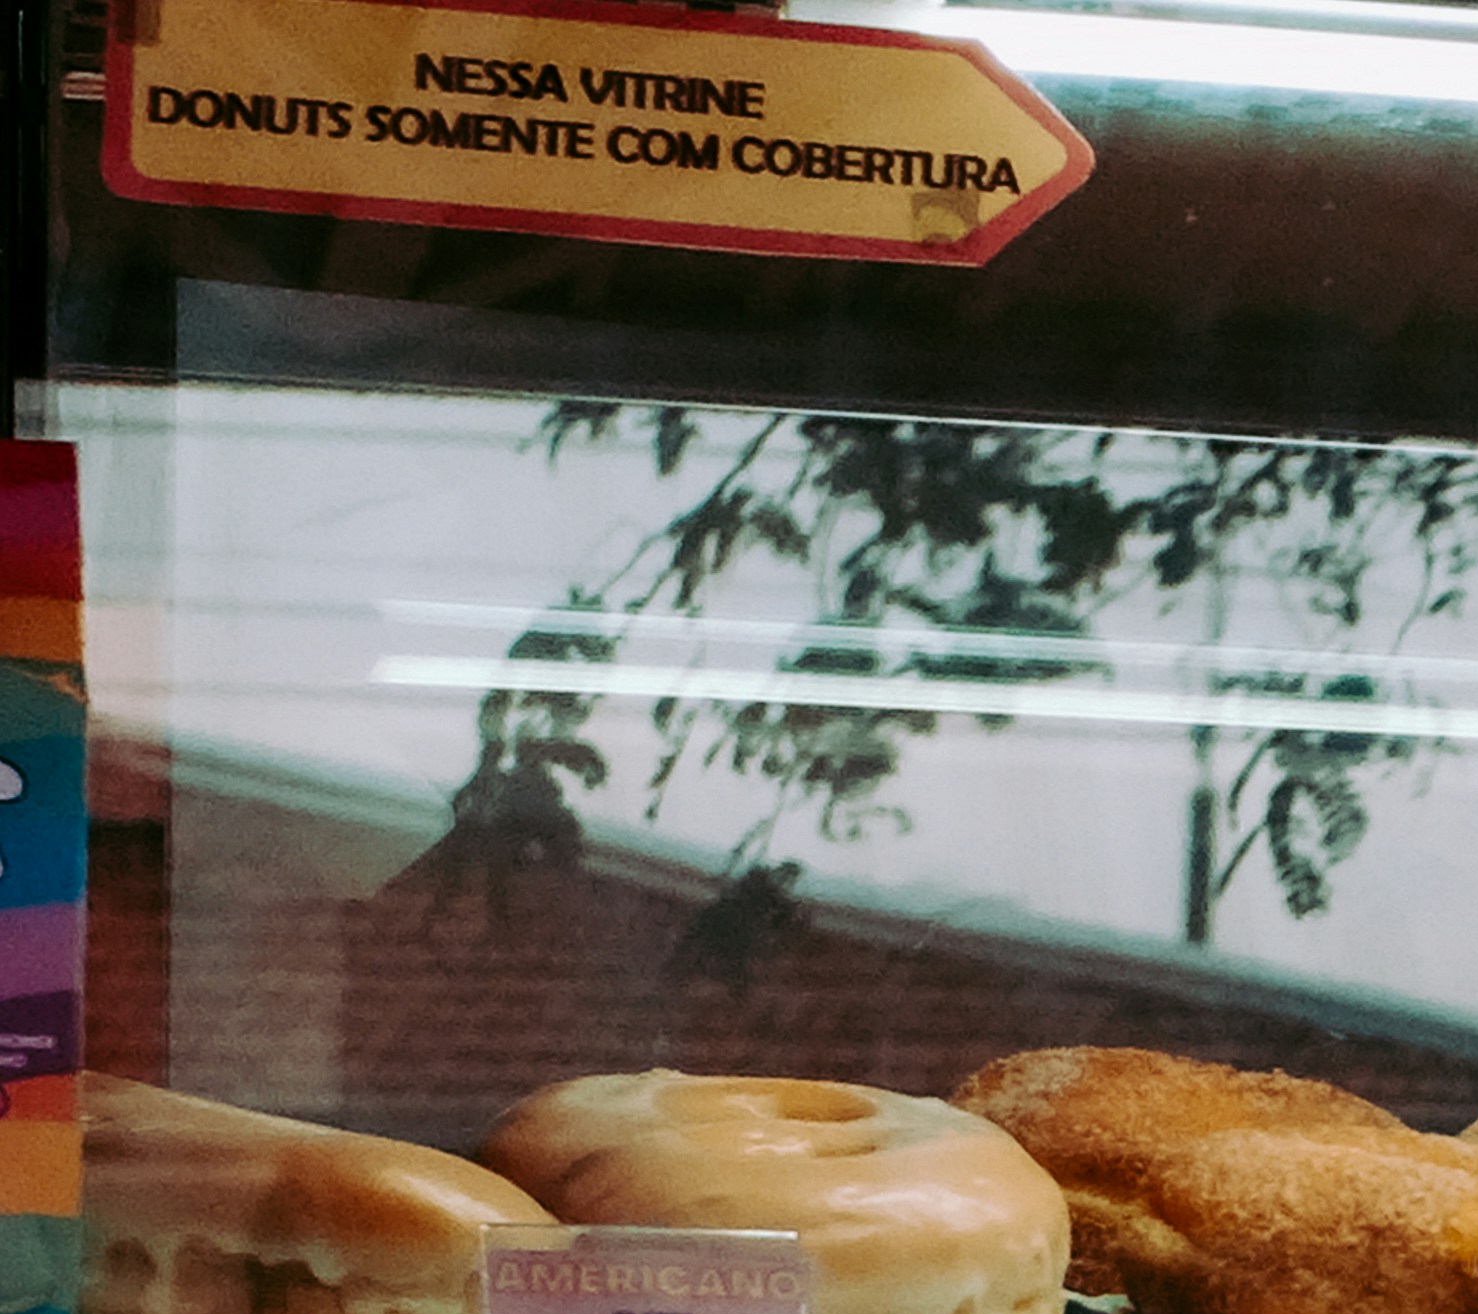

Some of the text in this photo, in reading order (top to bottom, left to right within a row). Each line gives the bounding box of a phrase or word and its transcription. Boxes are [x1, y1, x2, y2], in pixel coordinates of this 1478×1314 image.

[412, 52, 766, 120] NESSA VITRINE
[146, 86, 1021, 196] DONUTS SOMENTE COM COBERTURA
[496, 1261, 801, 1300] AMERICANO
